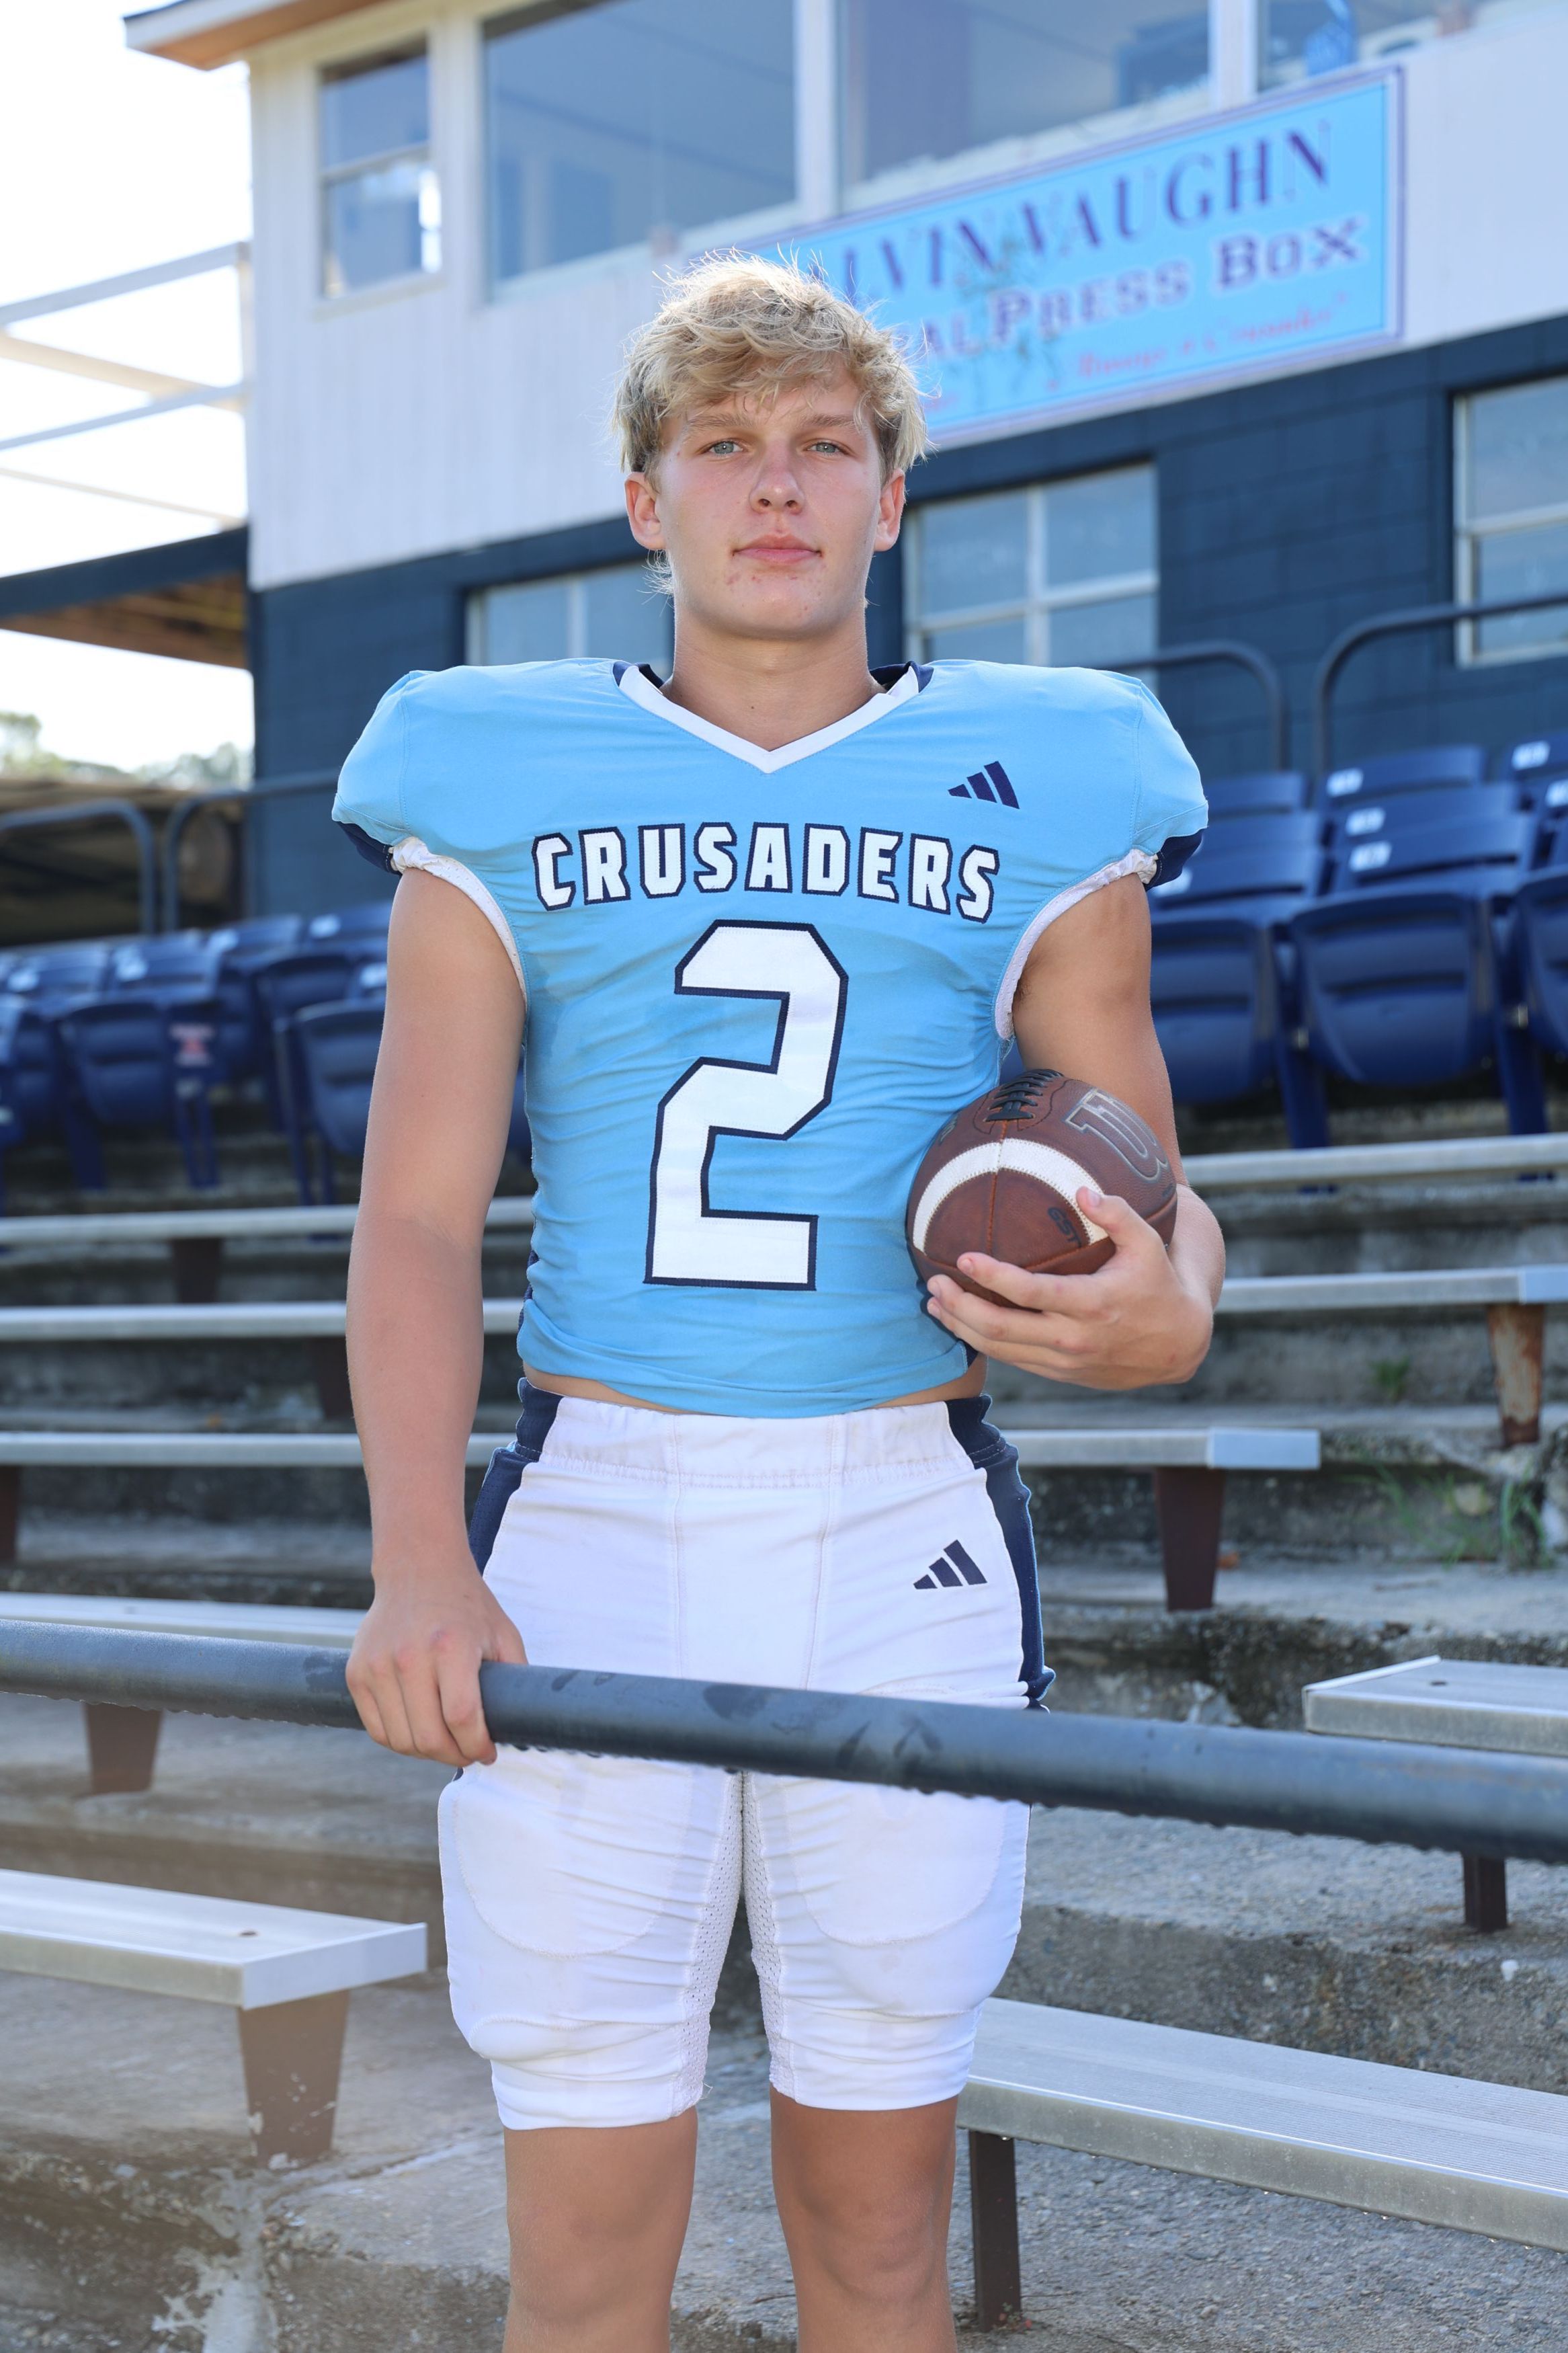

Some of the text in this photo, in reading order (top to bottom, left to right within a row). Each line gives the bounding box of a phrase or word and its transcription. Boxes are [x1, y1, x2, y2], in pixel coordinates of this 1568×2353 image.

[809, 118, 1331, 307] LVIN VAUGHN
[992, 261, 1190, 344] PRESS
[1216, 214, 1365, 289] BOX
[531, 822, 1000, 924] CRUSADERS
[643, 918, 849, 1291] 2
